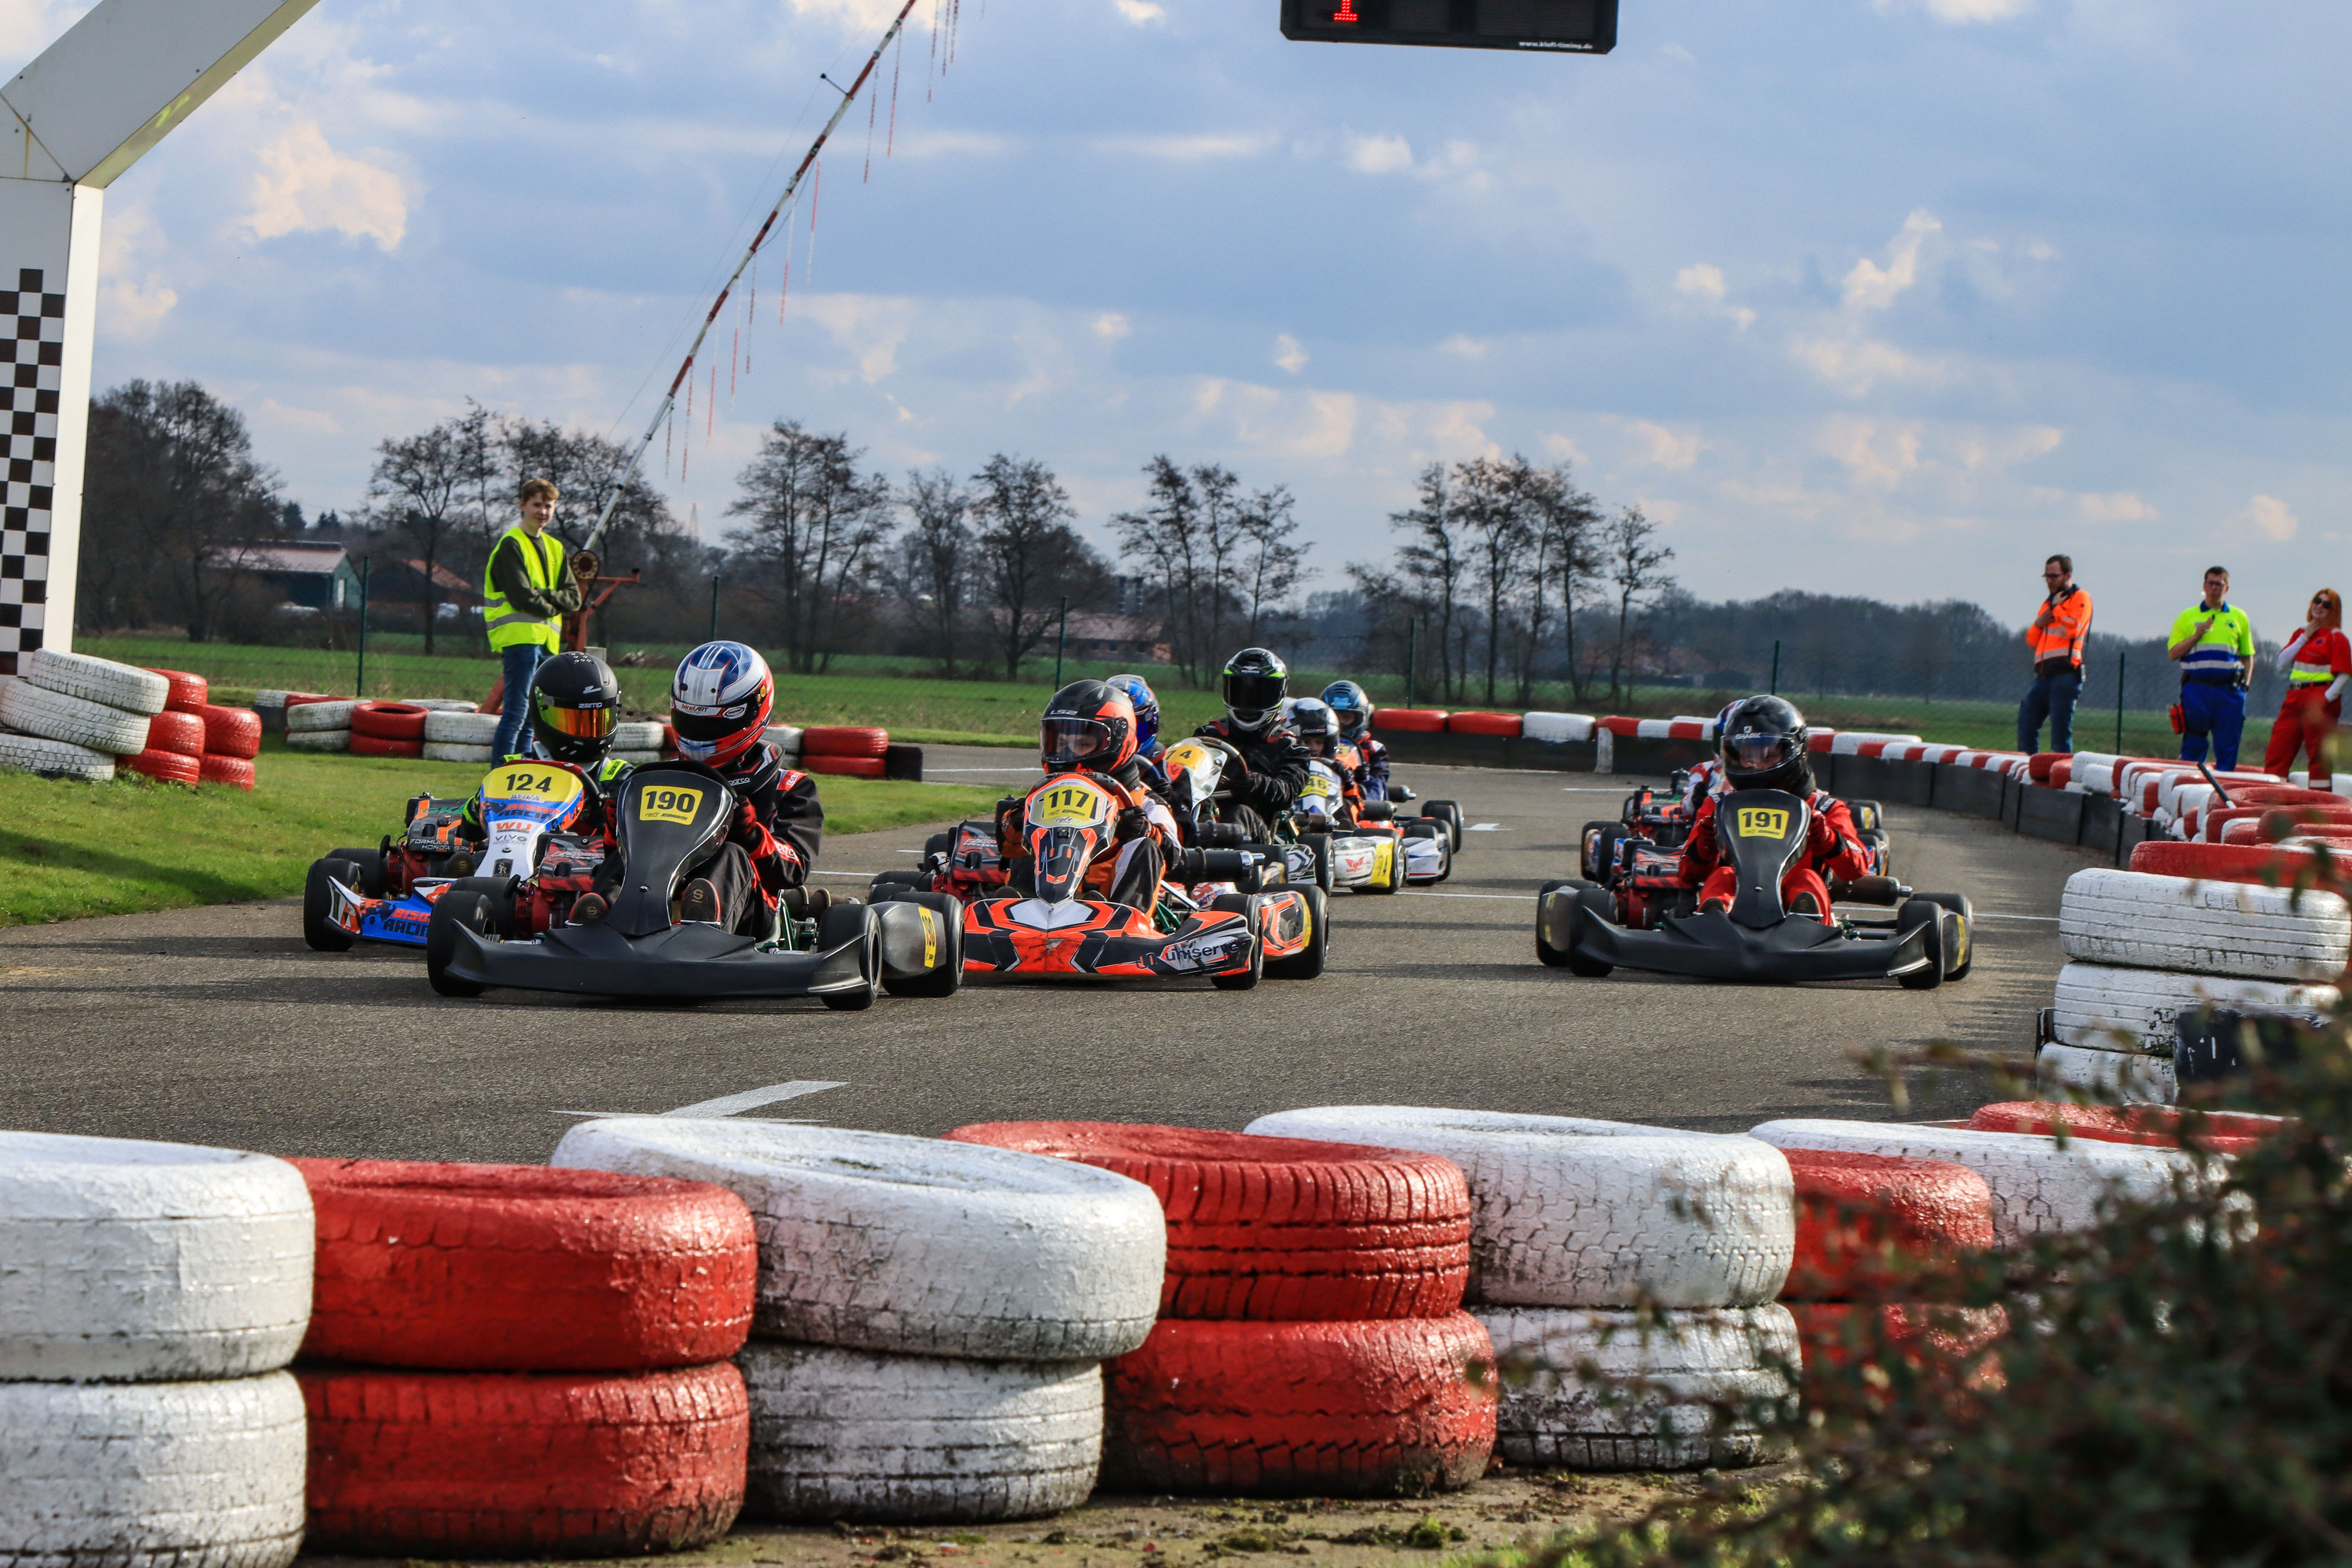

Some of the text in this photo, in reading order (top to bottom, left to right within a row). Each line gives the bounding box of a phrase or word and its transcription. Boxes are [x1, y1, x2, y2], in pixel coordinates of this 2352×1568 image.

[506, 774, 553, 793] 124
[728, 777, 751, 787] parco
[645, 791, 696, 813] 190
[1049, 789, 1090, 808] 117
[1742, 811, 1782, 830] 191
[409, 838, 449, 847] FORMULA
[391, 908, 431, 924] BISO
[921, 915, 936, 948] 190
